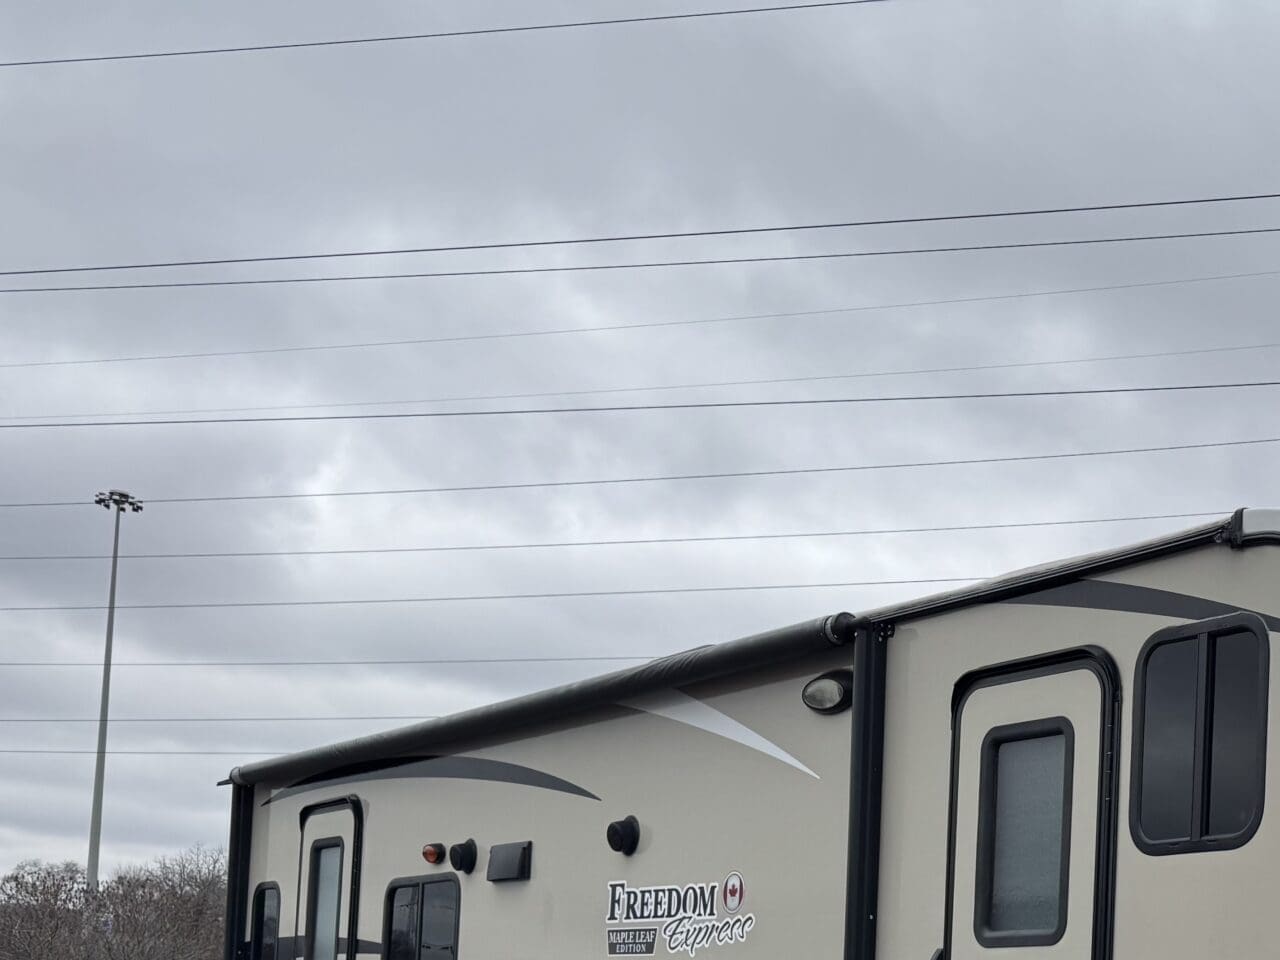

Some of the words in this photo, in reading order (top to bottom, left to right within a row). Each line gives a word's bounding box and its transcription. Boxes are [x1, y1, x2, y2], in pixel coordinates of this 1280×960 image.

[607, 883, 717, 921] FREEDOM
[608, 932, 634, 944] MAPLE
[635, 930, 656, 943] LEAF
[663, 916, 754, 954] Express
[616, 944, 646, 953] EDITION
